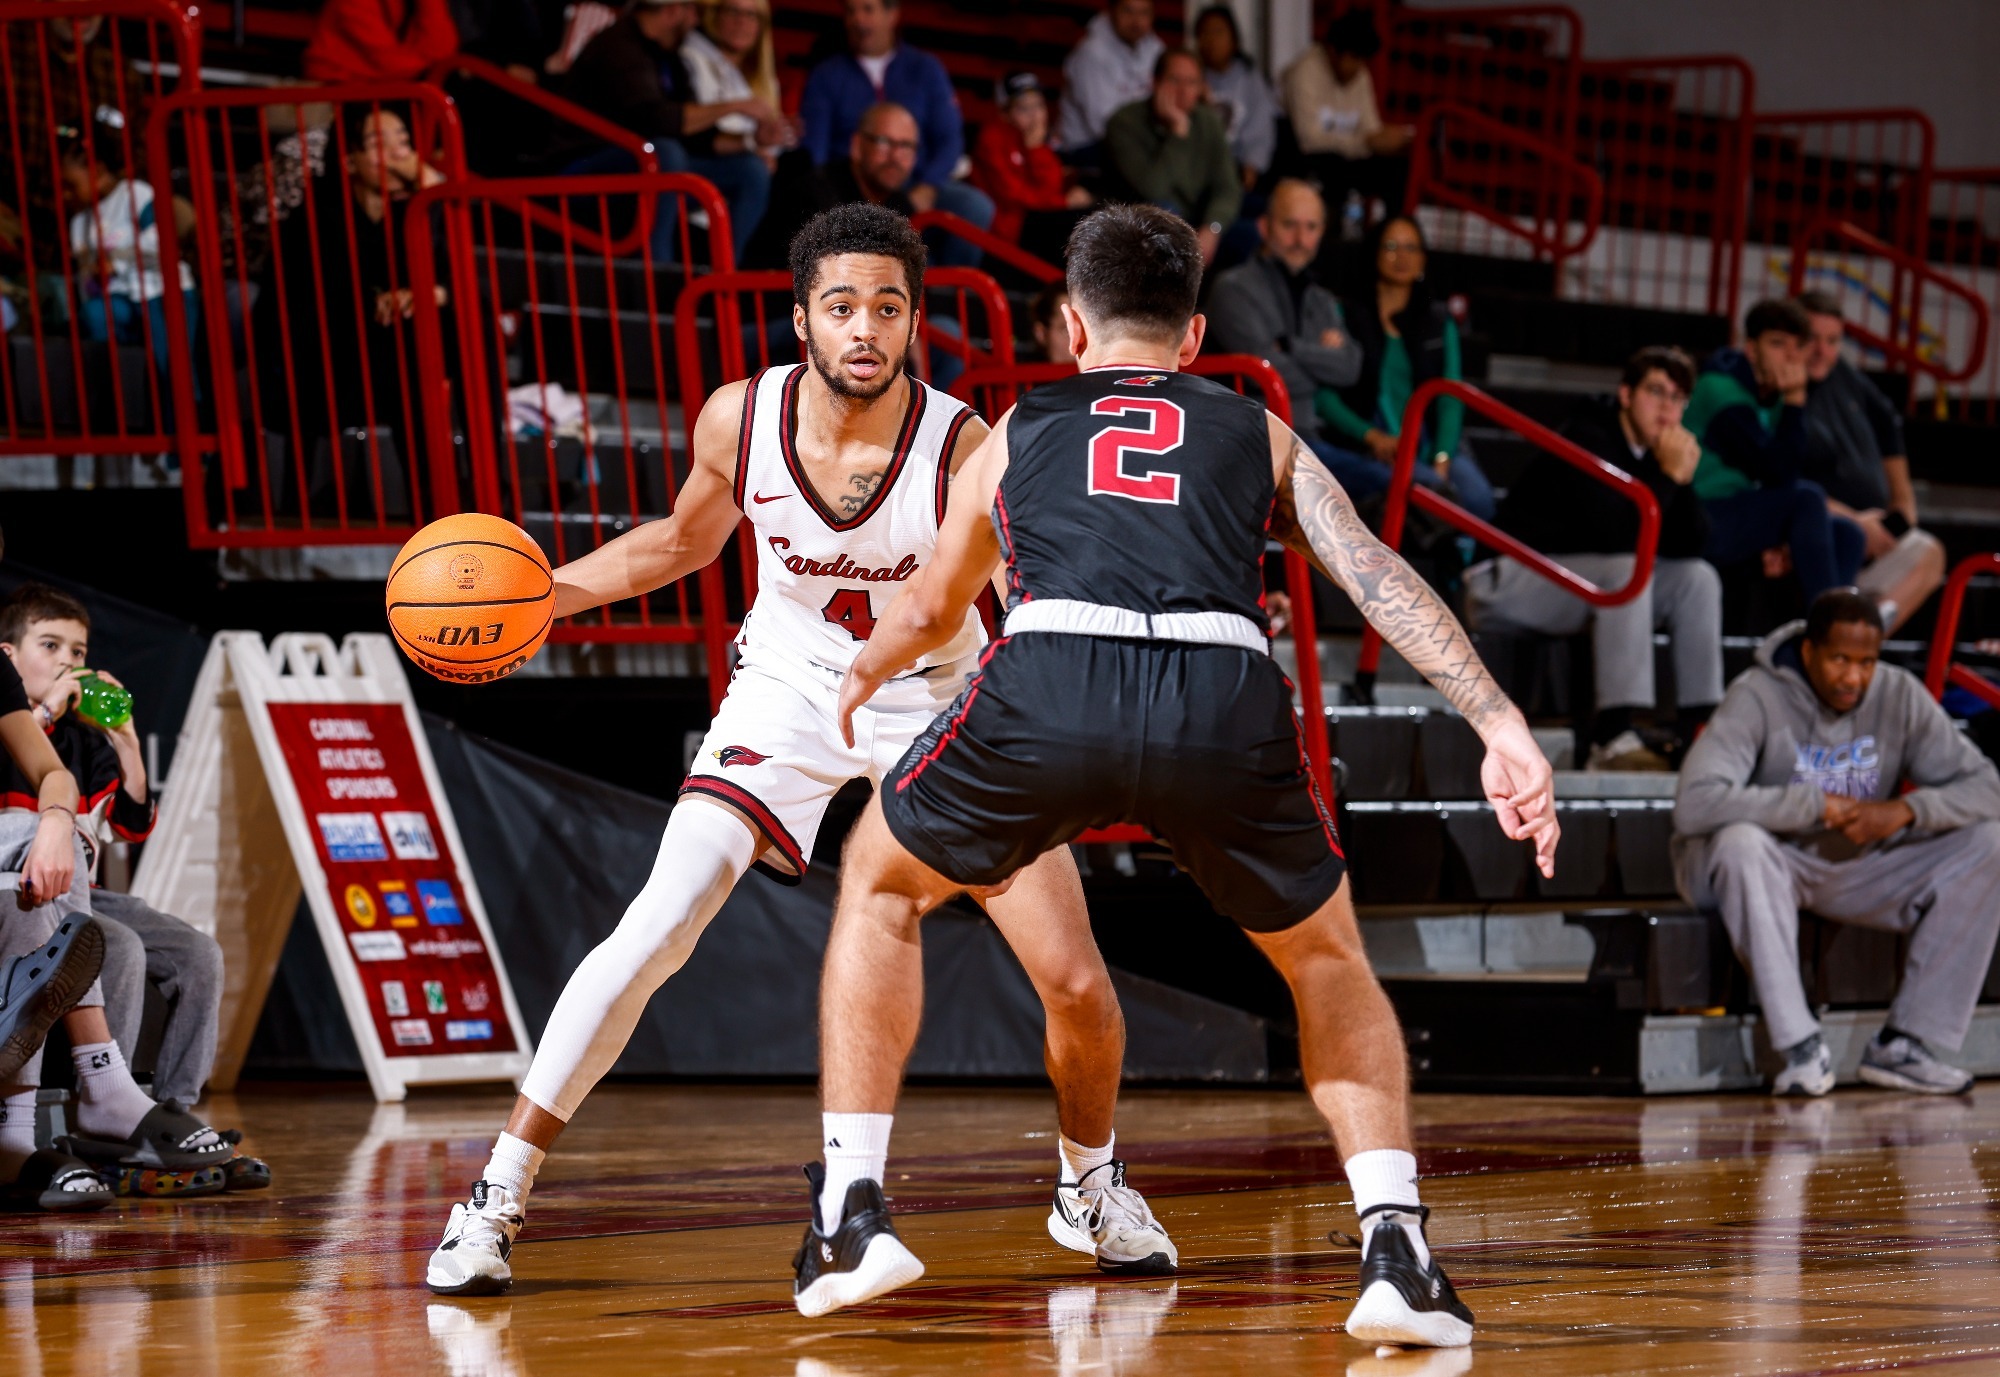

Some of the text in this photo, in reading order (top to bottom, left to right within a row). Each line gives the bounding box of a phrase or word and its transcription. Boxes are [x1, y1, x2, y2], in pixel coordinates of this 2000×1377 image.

[1088, 395, 1185, 506] 2
[437, 622, 504, 646] EVO
[821, 588, 878, 641] 4
